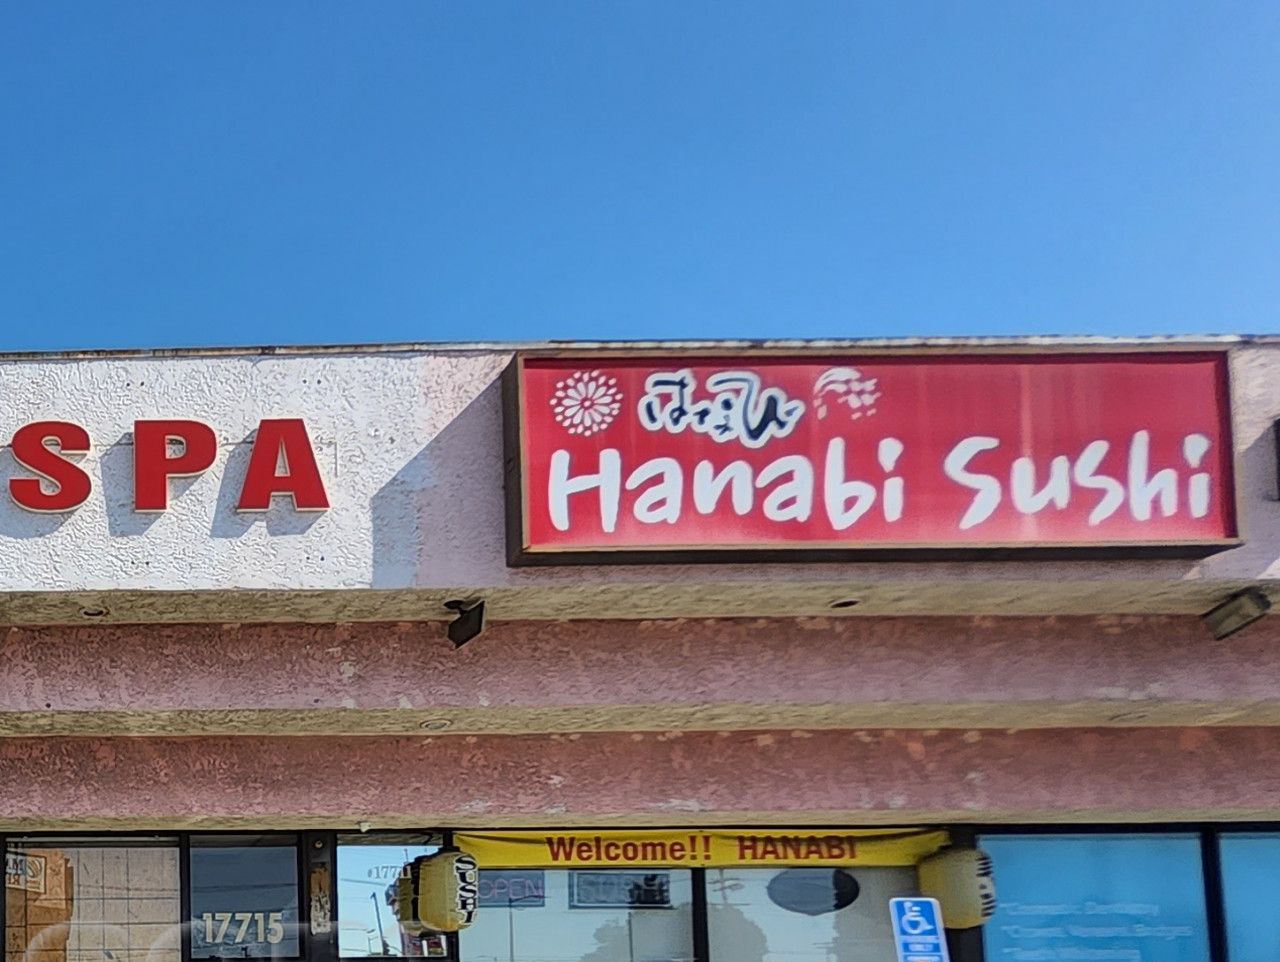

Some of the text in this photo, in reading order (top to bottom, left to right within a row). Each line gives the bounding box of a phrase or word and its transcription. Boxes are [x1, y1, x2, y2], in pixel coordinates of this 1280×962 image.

[8, 418, 330, 513] SPA
[547, 430, 1213, 533] Hanabi Sushi
[546, 835, 858, 863] Welcome!! HANABI
[453, 853, 480, 925] SUSHI
[478, 878, 545, 900] OPEN
[201, 911, 285, 945] 17715
